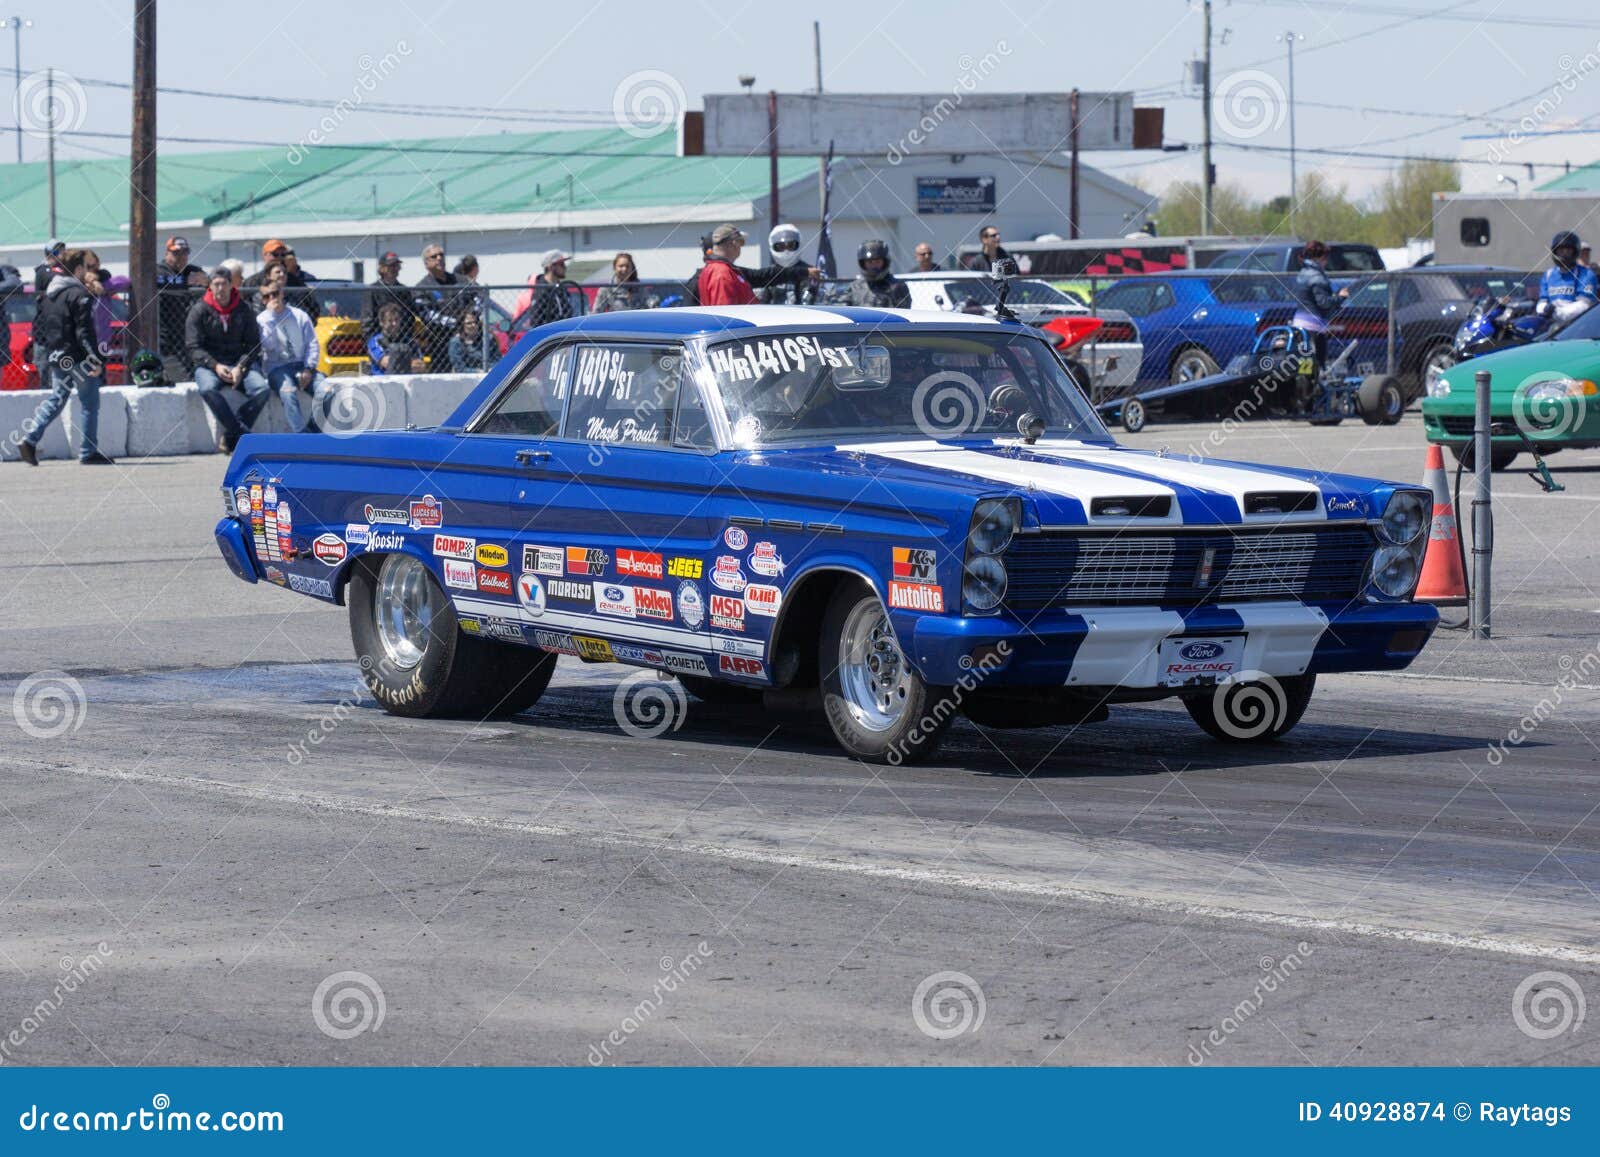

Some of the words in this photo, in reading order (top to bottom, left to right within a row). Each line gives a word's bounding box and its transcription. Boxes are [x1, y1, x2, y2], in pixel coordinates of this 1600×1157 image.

[365, 530, 404, 552] Hoosier
[436, 537, 465, 553] COMP
[479, 548, 505, 561] Milodon
[524, 548, 540, 570] ATI
[629, 552, 663, 577] Aeroquip
[480, 574, 509, 589] Edelbrock
[548, 580, 591, 600] MOROSO
[607, 588, 621, 600] Ford
[892, 584, 941, 610] Autolite
[600, 601, 632, 613] RACING
[634, 587, 672, 618] Holley
[712, 596, 743, 620] MSD
[723, 641, 735, 652] 289
[1188, 644, 1217, 658] Ford
[665, 655, 705, 671] COMETIC
[720, 655, 763, 675] ARP
[1167, 662, 1235, 674] RACING
